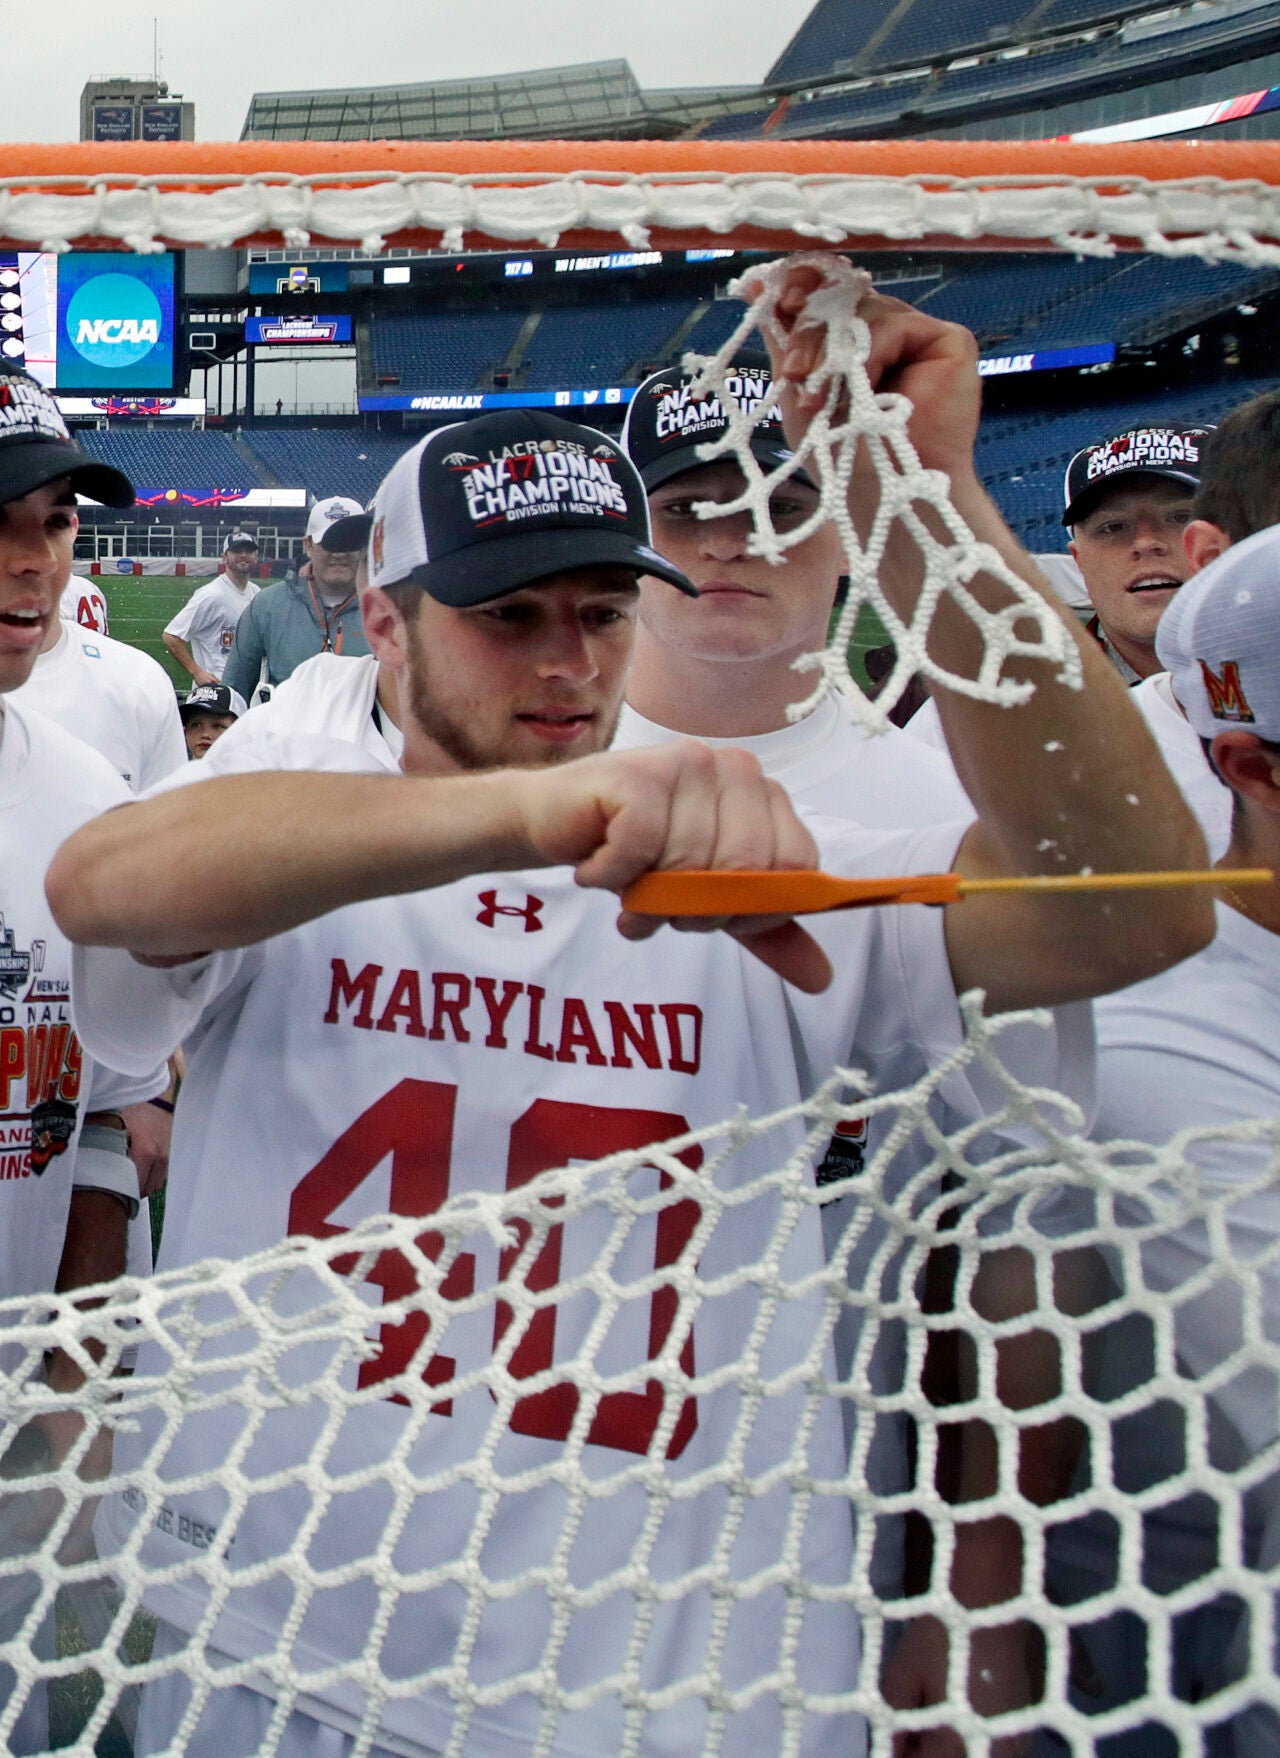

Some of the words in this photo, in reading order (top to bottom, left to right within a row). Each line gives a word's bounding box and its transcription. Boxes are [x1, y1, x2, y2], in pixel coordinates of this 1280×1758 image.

[76, 319, 158, 344] NCAA
[266, 328, 330, 338] CHAMPIONSHIPS
[411, 395, 483, 410] #NCAALAX
[682, 418, 725, 436] DIVISION
[1087, 446, 1199, 480] CHAMPIONS
[1105, 461, 1138, 476] DIVISION
[468, 477, 628, 520] CHAMPIONS
[506, 502, 559, 521] DIVISION
[570, 502, 605, 516] MEN'S
[1197, 658, 1254, 720] M
[323, 957, 704, 1076] MARYLAND
